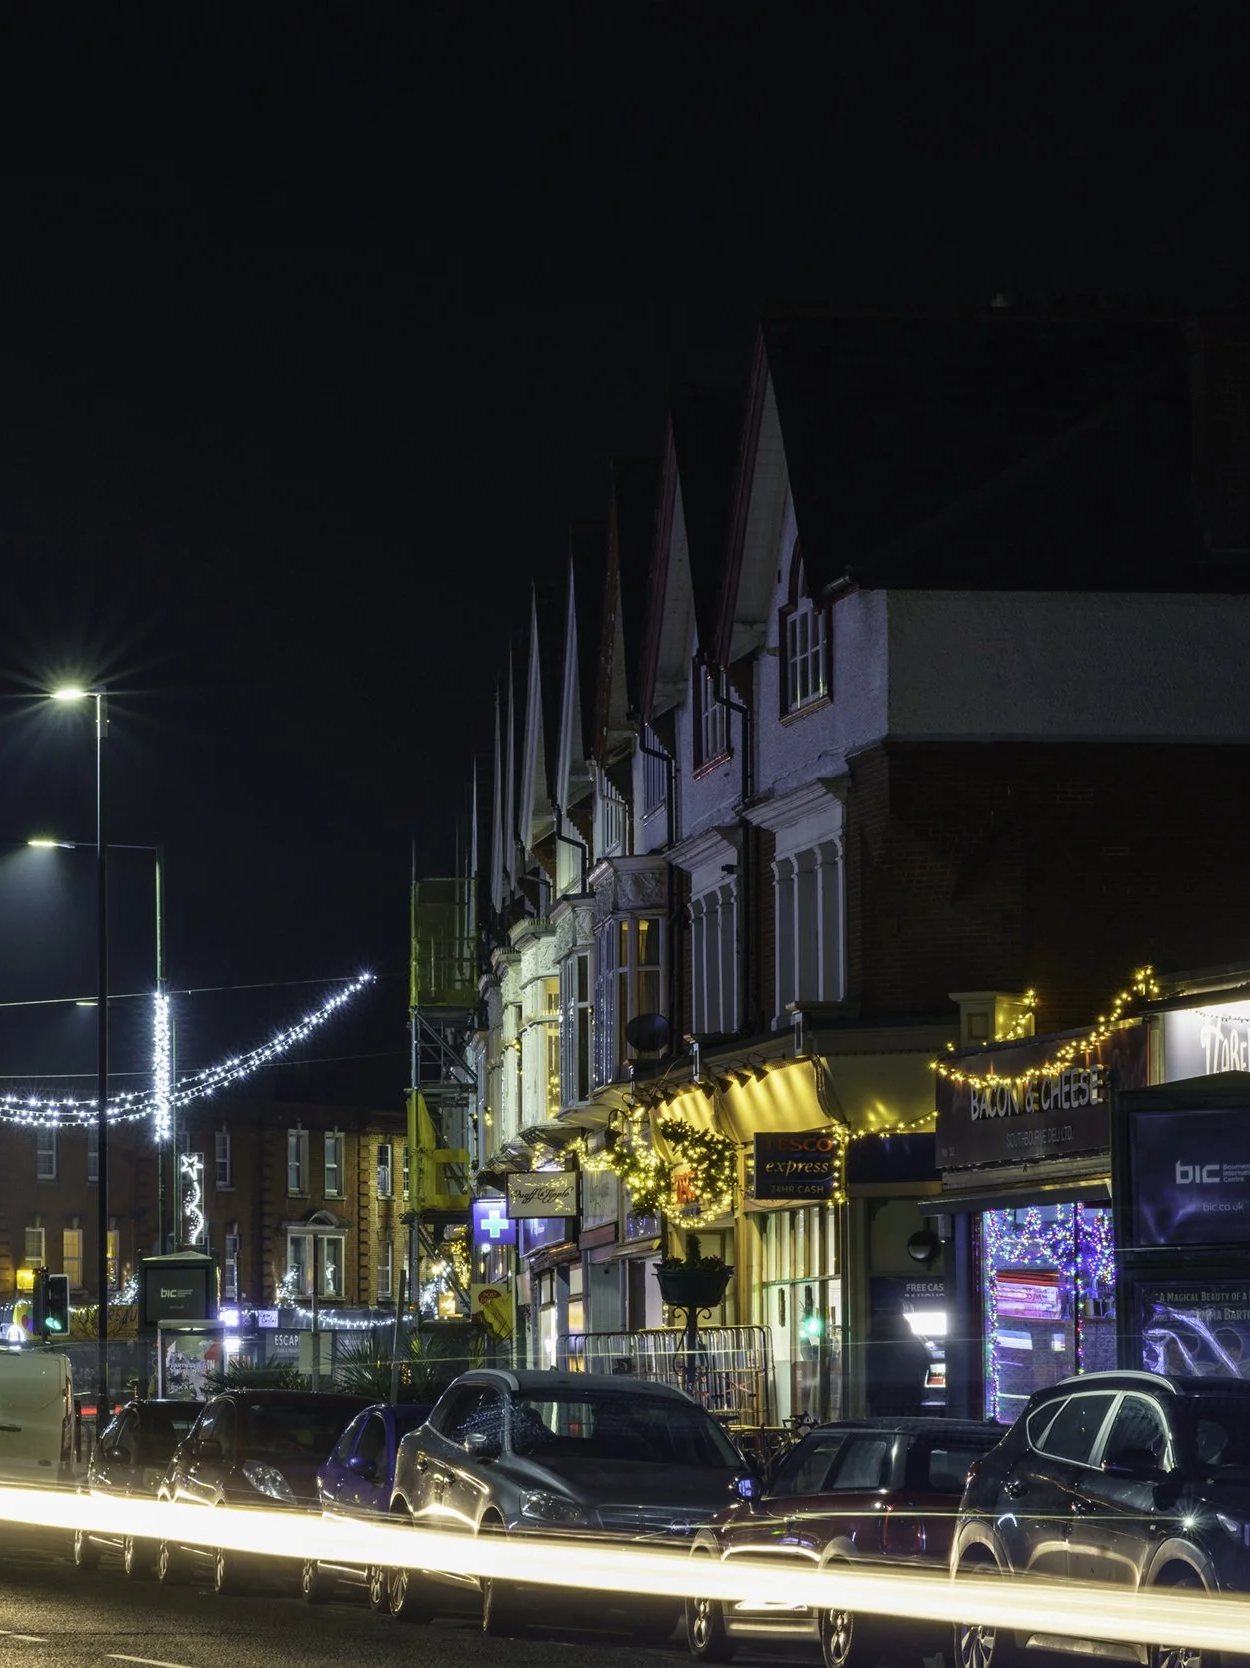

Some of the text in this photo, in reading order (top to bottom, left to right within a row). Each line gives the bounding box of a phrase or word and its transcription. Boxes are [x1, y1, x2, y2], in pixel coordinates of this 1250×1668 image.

[970, 1082, 1020, 1121] BACON
[1041, 1064, 1103, 1110] CHEESE
[765, 1138, 833, 1152] TESCO
[766, 1160, 829, 1175] express
[1175, 1160, 1220, 1184] bic
[797, 1185, 824, 1194] CASH
[1202, 1201, 1244, 1211] bic.co.uk
[160, 1287, 177, 1298] bic
[906, 1283, 927, 1292] FREE
[1201, 1291, 1230, 1301] BEAUTY
